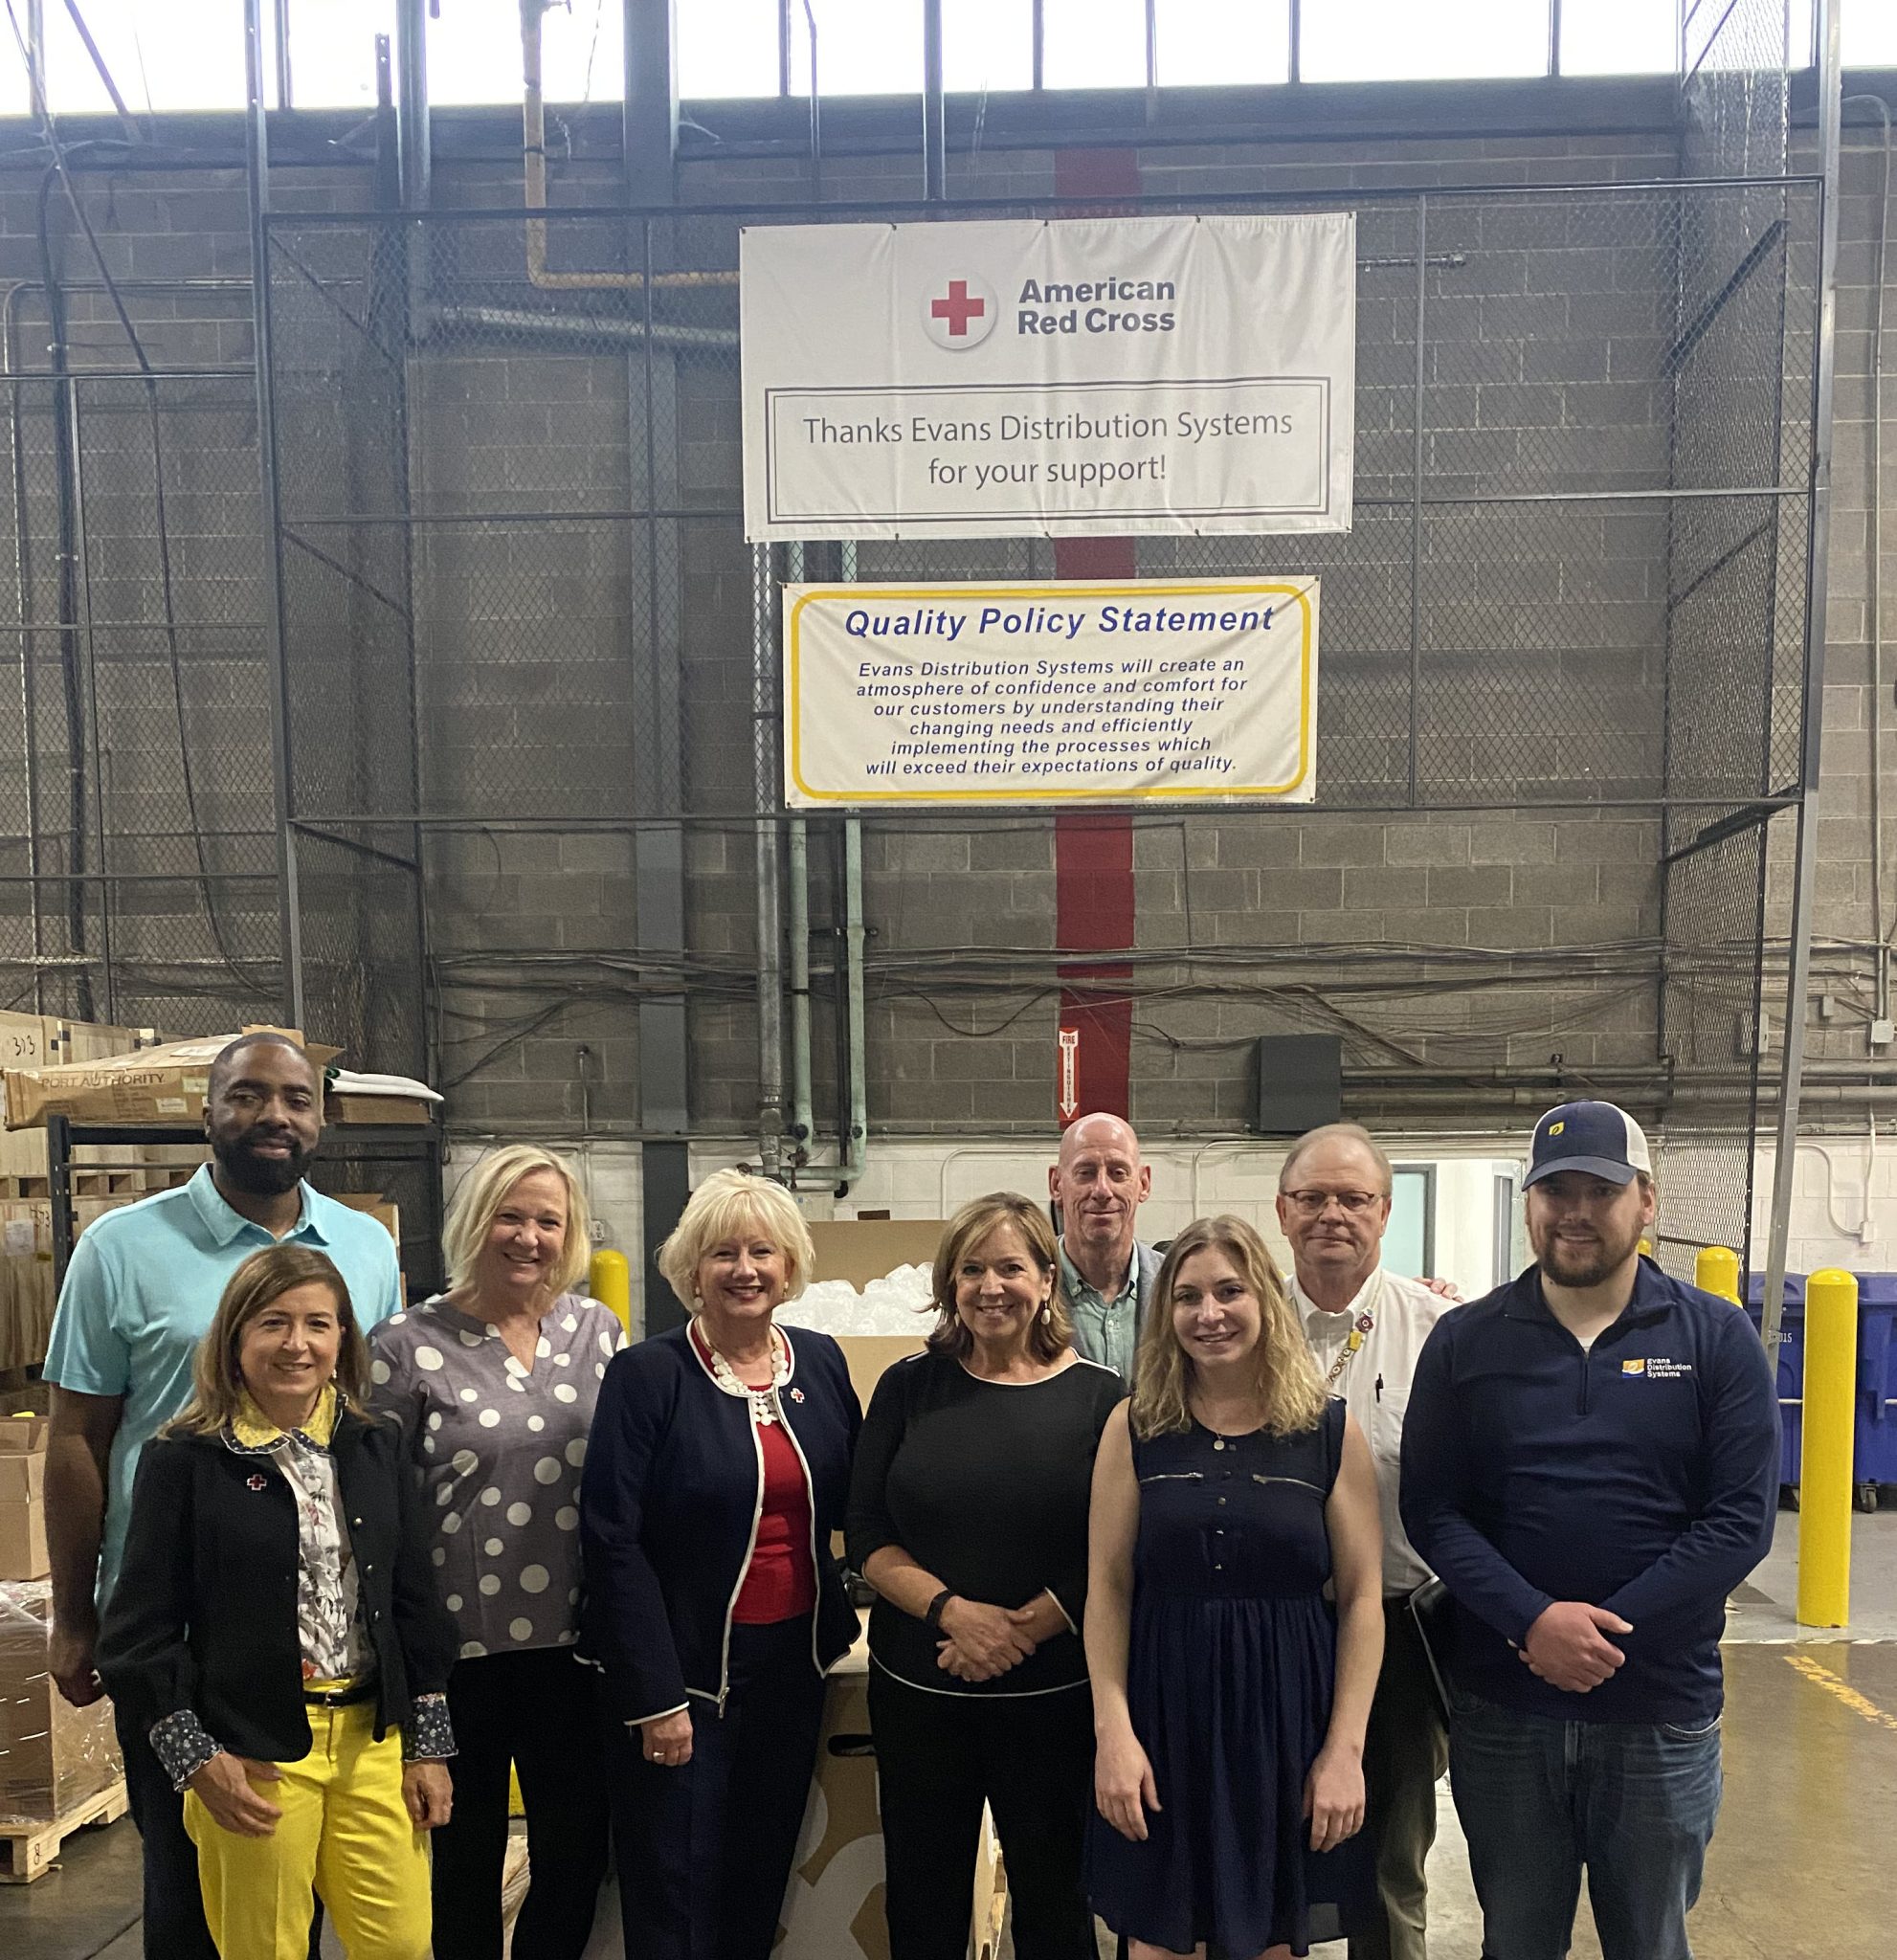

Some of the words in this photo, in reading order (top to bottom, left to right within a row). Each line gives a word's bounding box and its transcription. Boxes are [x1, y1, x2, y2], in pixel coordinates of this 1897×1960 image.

[1018, 277, 1175, 303] American
[1018, 309, 1077, 335] Red
[1085, 307, 1175, 333] Cross
[803, 417, 903, 443] Thanks
[912, 417, 992, 442] Evans
[1001, 412, 1167, 440] Distribution
[1177, 412, 1292, 443] Systems
[928, 457, 968, 484] for
[974, 462, 1038, 491] your
[1047, 454, 1166, 488] support!
[845, 610, 967, 641] Quality
[979, 607, 1085, 639] Policy
[1098, 605, 1274, 633] Statement
[859, 662, 913, 677] Evans
[921, 660, 1029, 676] Distribution
[1036, 659, 1113, 678] Systems
[1122, 658, 1152, 673] will
[1159, 658, 1216, 673] create
[1222, 659, 1244, 671] an
[857, 681, 964, 699] atmosphere
[971, 680, 990, 695] of
[994, 679, 1096, 695] confidence
[1103, 679, 1137, 693] and
[1143, 678, 1215, 692] comfort
[1221, 677, 1247, 691] for
[874, 704, 904, 716] our
[910, 702, 1005, 715] customers
[1013, 701, 1035, 718] by
[1041, 699, 1174, 715] understanding
[1181, 697, 1224, 712] their
[910, 721, 993, 738] changing
[1000, 720, 1055, 734] needs
[1061, 719, 1095, 733] and
[1102, 718, 1193, 734] efficiently
[891, 740, 1015, 757] implementing
[1022, 740, 1050, 753] the
[1056, 741, 1150, 756] processes
[1158, 737, 1211, 751] which
[866, 761, 897, 774] will
[903, 760, 967, 774] exceed
[973, 759, 1015, 773] their
[1021, 758, 1139, 776] expectations
[1146, 757, 1165, 771] of
[1170, 756, 1237, 773] quality.
[1062, 1036, 1075, 1044] FIRE
[41, 1078, 77, 1088] PORT
[80, 1073, 165, 1087] AUTHORITY
